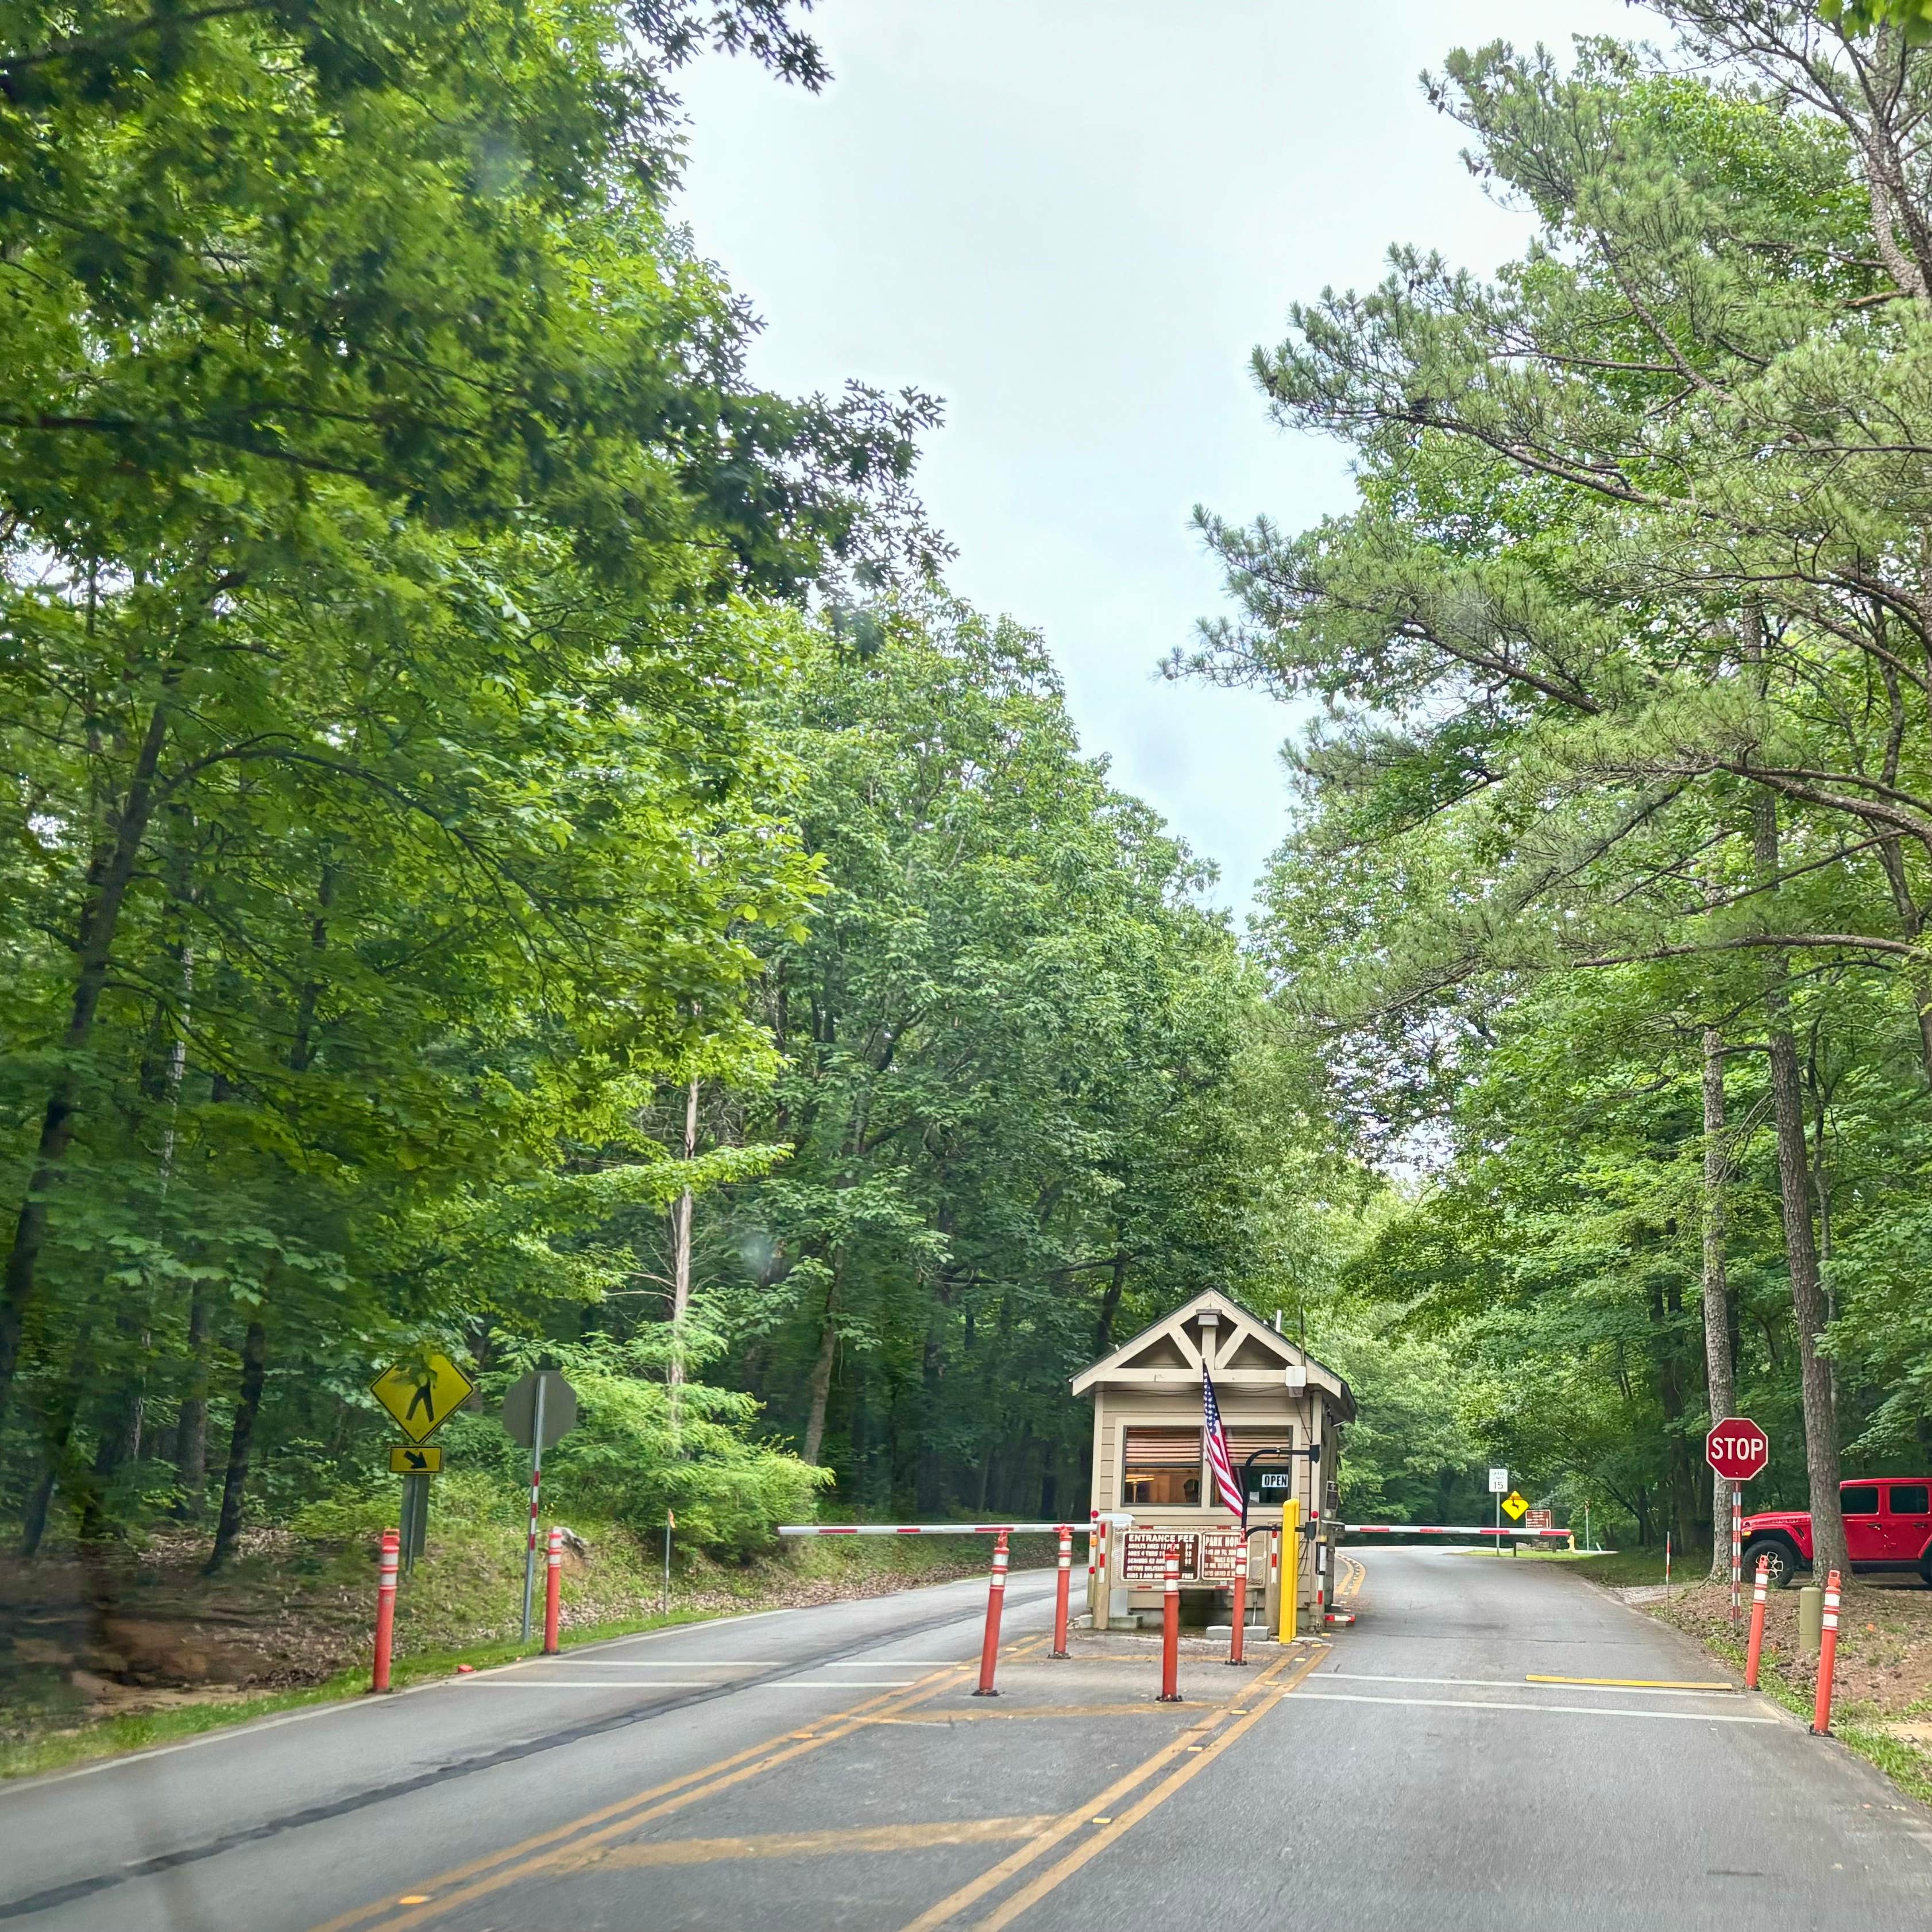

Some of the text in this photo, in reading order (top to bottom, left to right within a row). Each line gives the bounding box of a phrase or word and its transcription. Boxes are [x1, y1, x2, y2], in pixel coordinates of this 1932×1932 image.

[1711, 1437, 1763, 1460] STOP
[1265, 1475, 1287, 1486] OPEN
[1177, 1535, 1195, 1543] FEE
[1205, 1536, 1223, 1547] PARK
